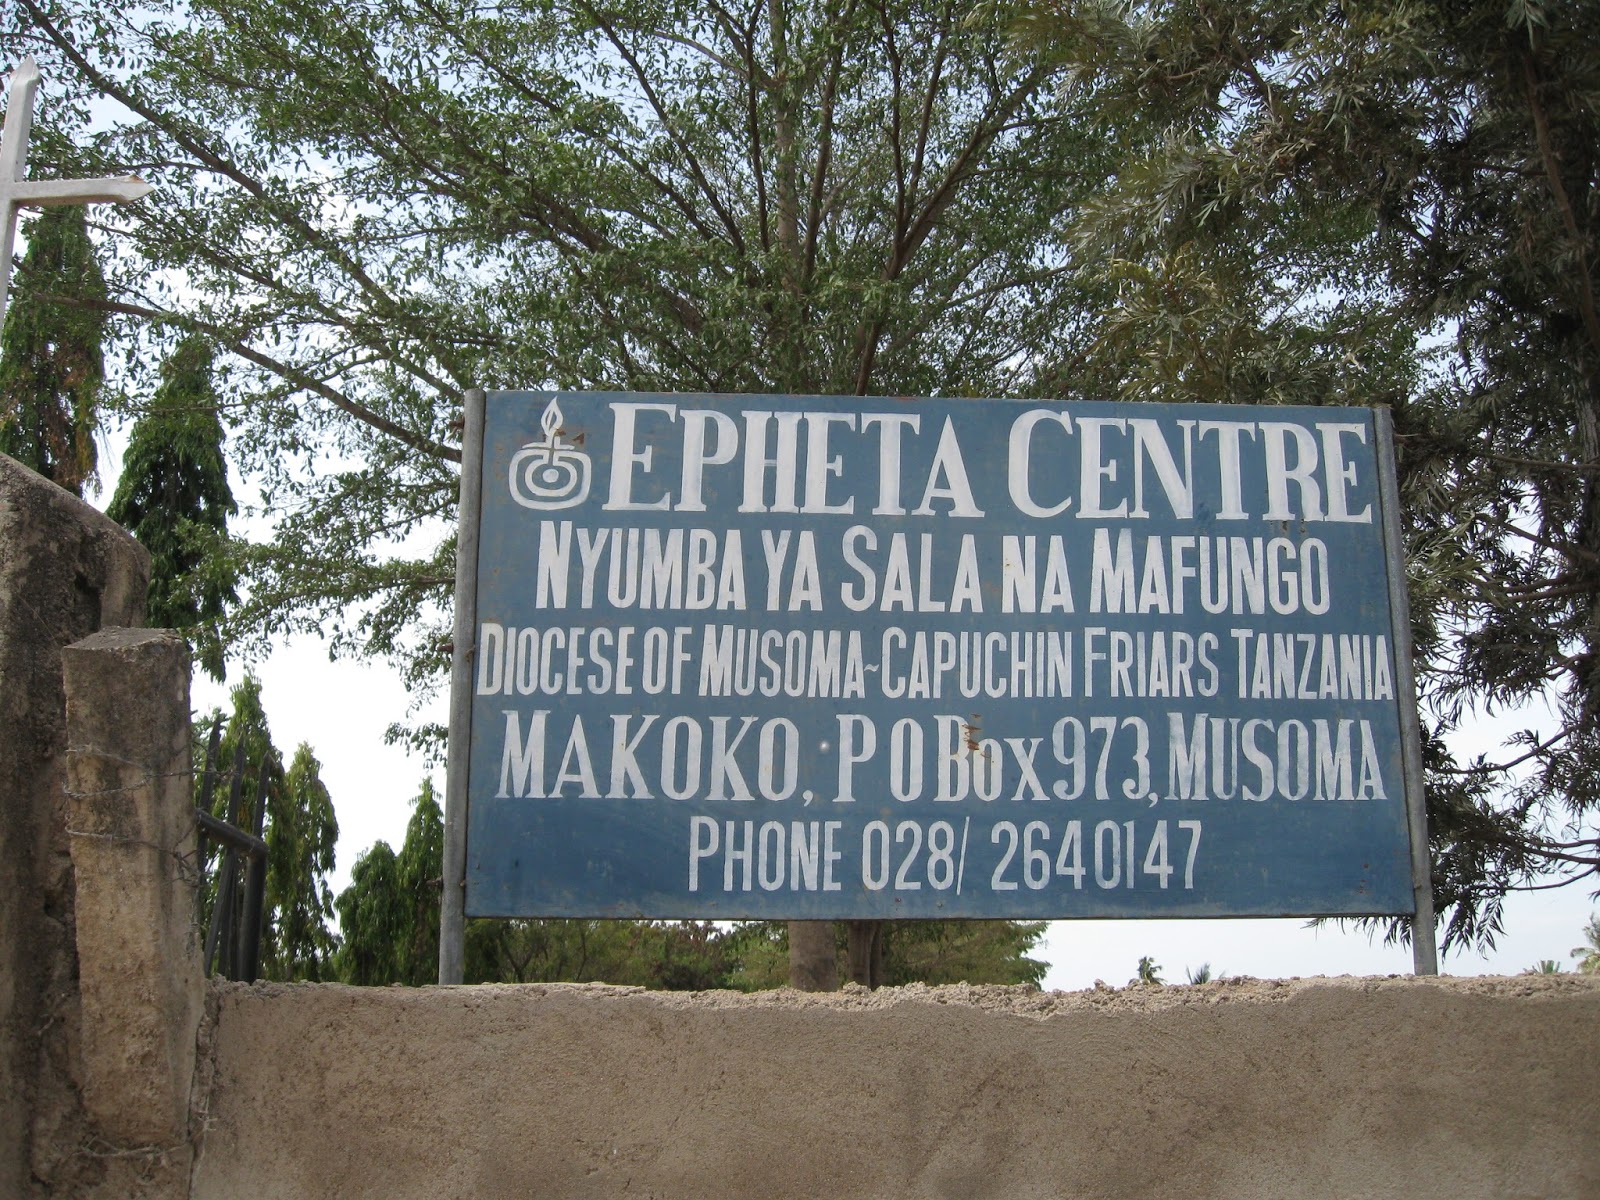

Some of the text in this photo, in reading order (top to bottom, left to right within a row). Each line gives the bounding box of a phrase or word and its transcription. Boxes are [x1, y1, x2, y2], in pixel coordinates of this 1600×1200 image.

[601, 402, 1373, 525] EPHETA CENTRE
[535, 520, 1331, 616] NYUMBA YA SALA NA MAFUNGO
[476, 622, 635, 696] DIOCESE
[642, 626, 693, 695] OF
[1084, 626, 1219, 698] FRIARS
[1230, 628, 1394, 701] TANZANIA
[495, 709, 814, 807] MAKOKO,
[933, 714, 1051, 802] Box
[1052, 716, 1159, 808] 973,
[1164, 712, 1388, 802] MUSOMA
[688, 815, 1202, 896] PHONE 028/ 2640147
